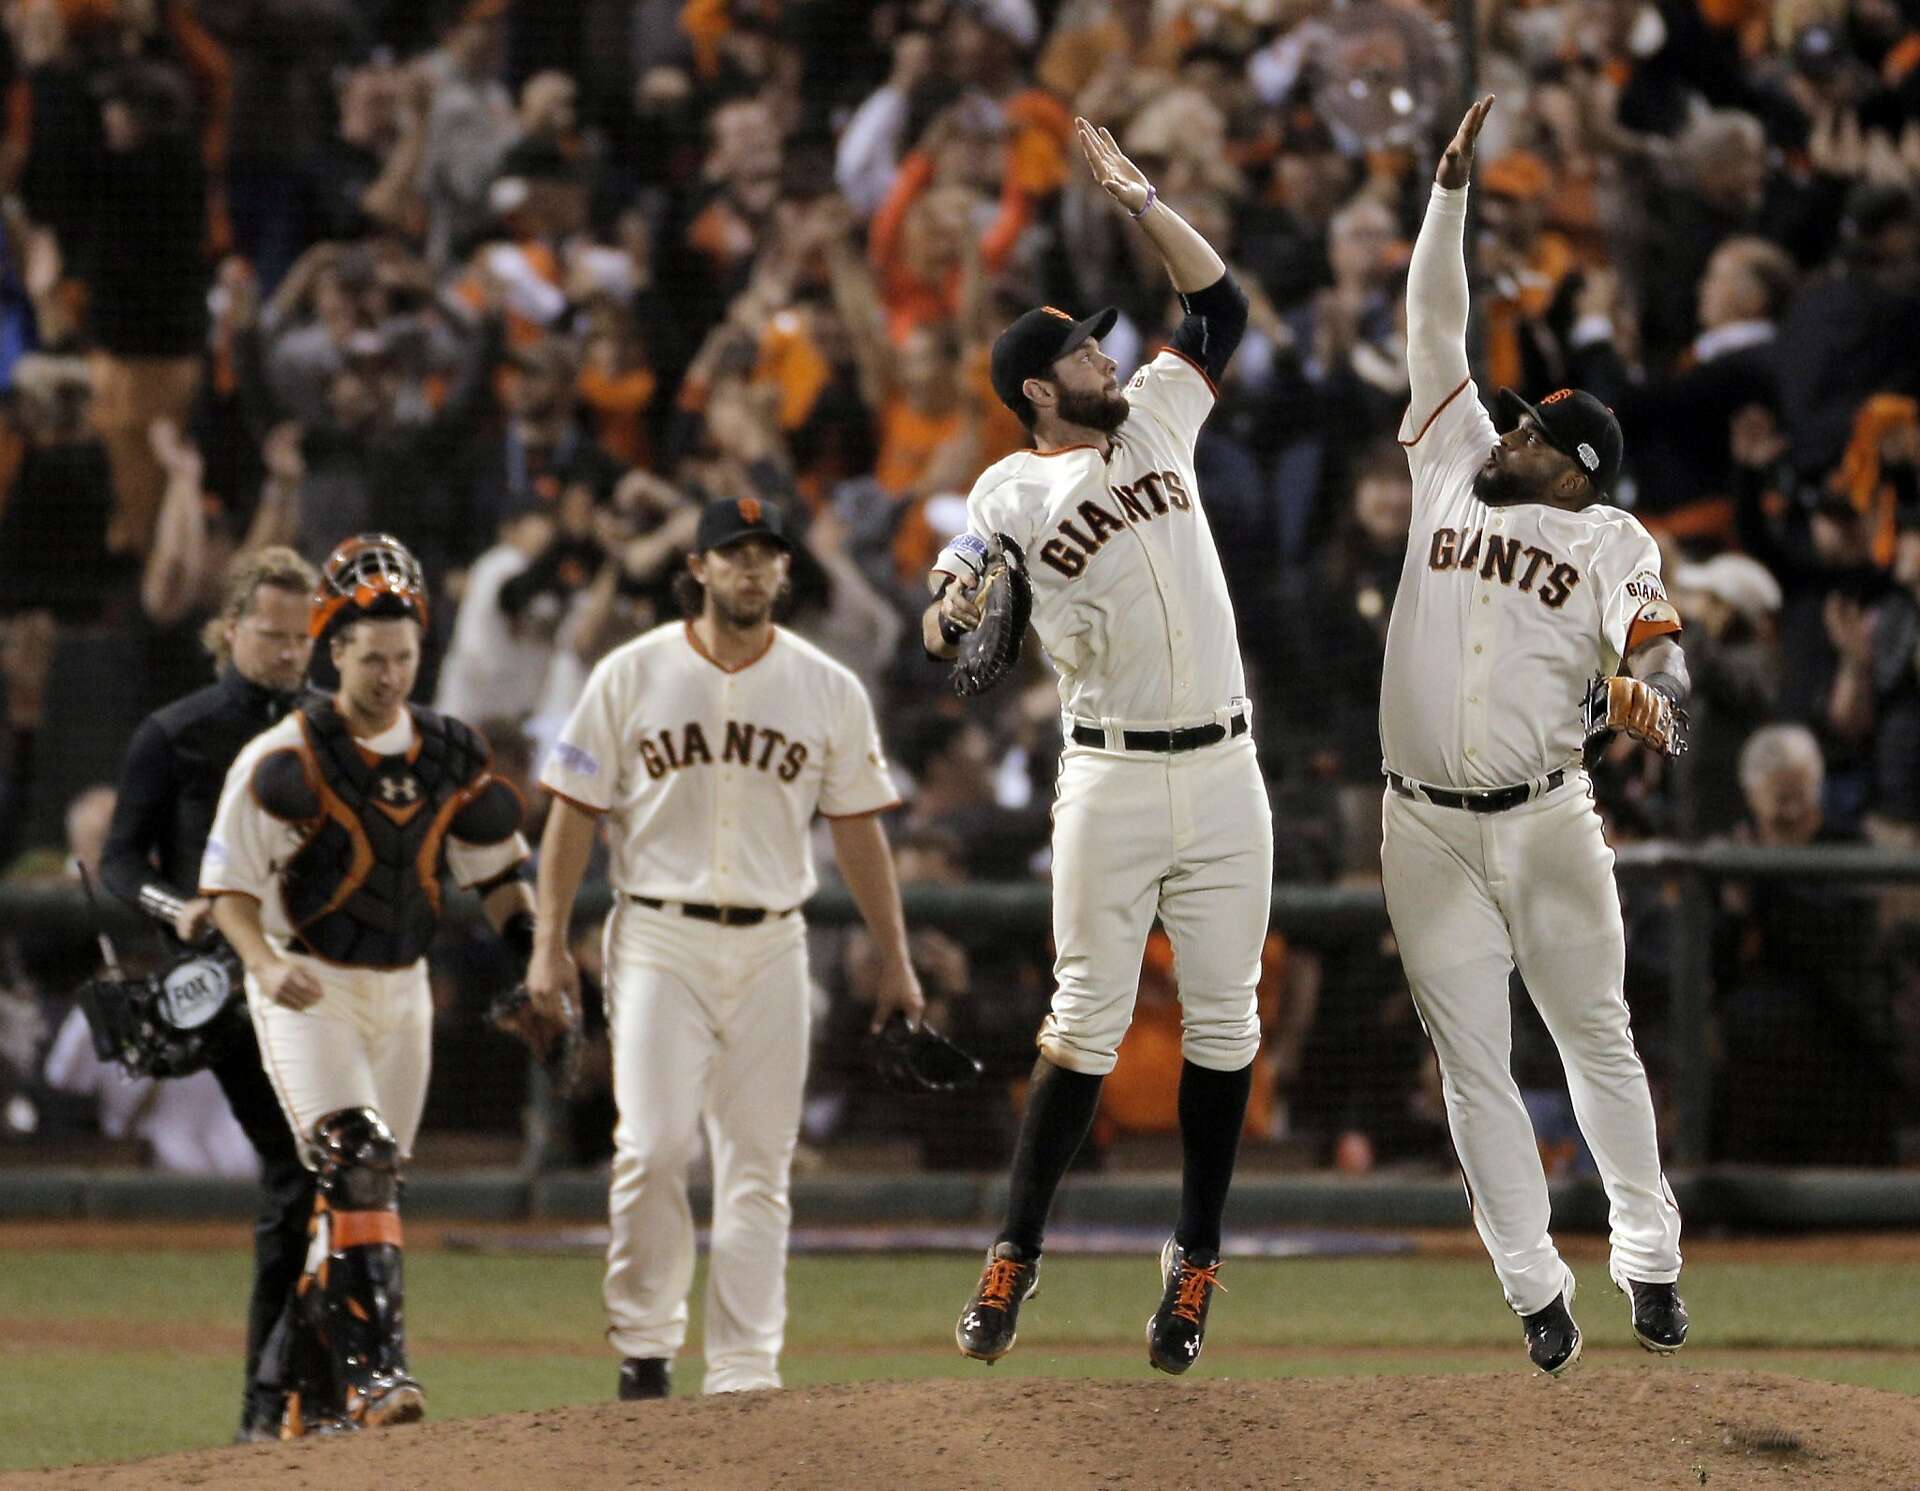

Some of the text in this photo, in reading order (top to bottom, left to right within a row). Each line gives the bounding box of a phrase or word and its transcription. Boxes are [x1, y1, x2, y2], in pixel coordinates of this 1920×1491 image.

[1040, 471, 1192, 579] GIANTS
[1626, 582, 1665, 600] GIAN
[640, 721, 807, 782] GIANTS
[173, 976, 210, 1008] FOX
